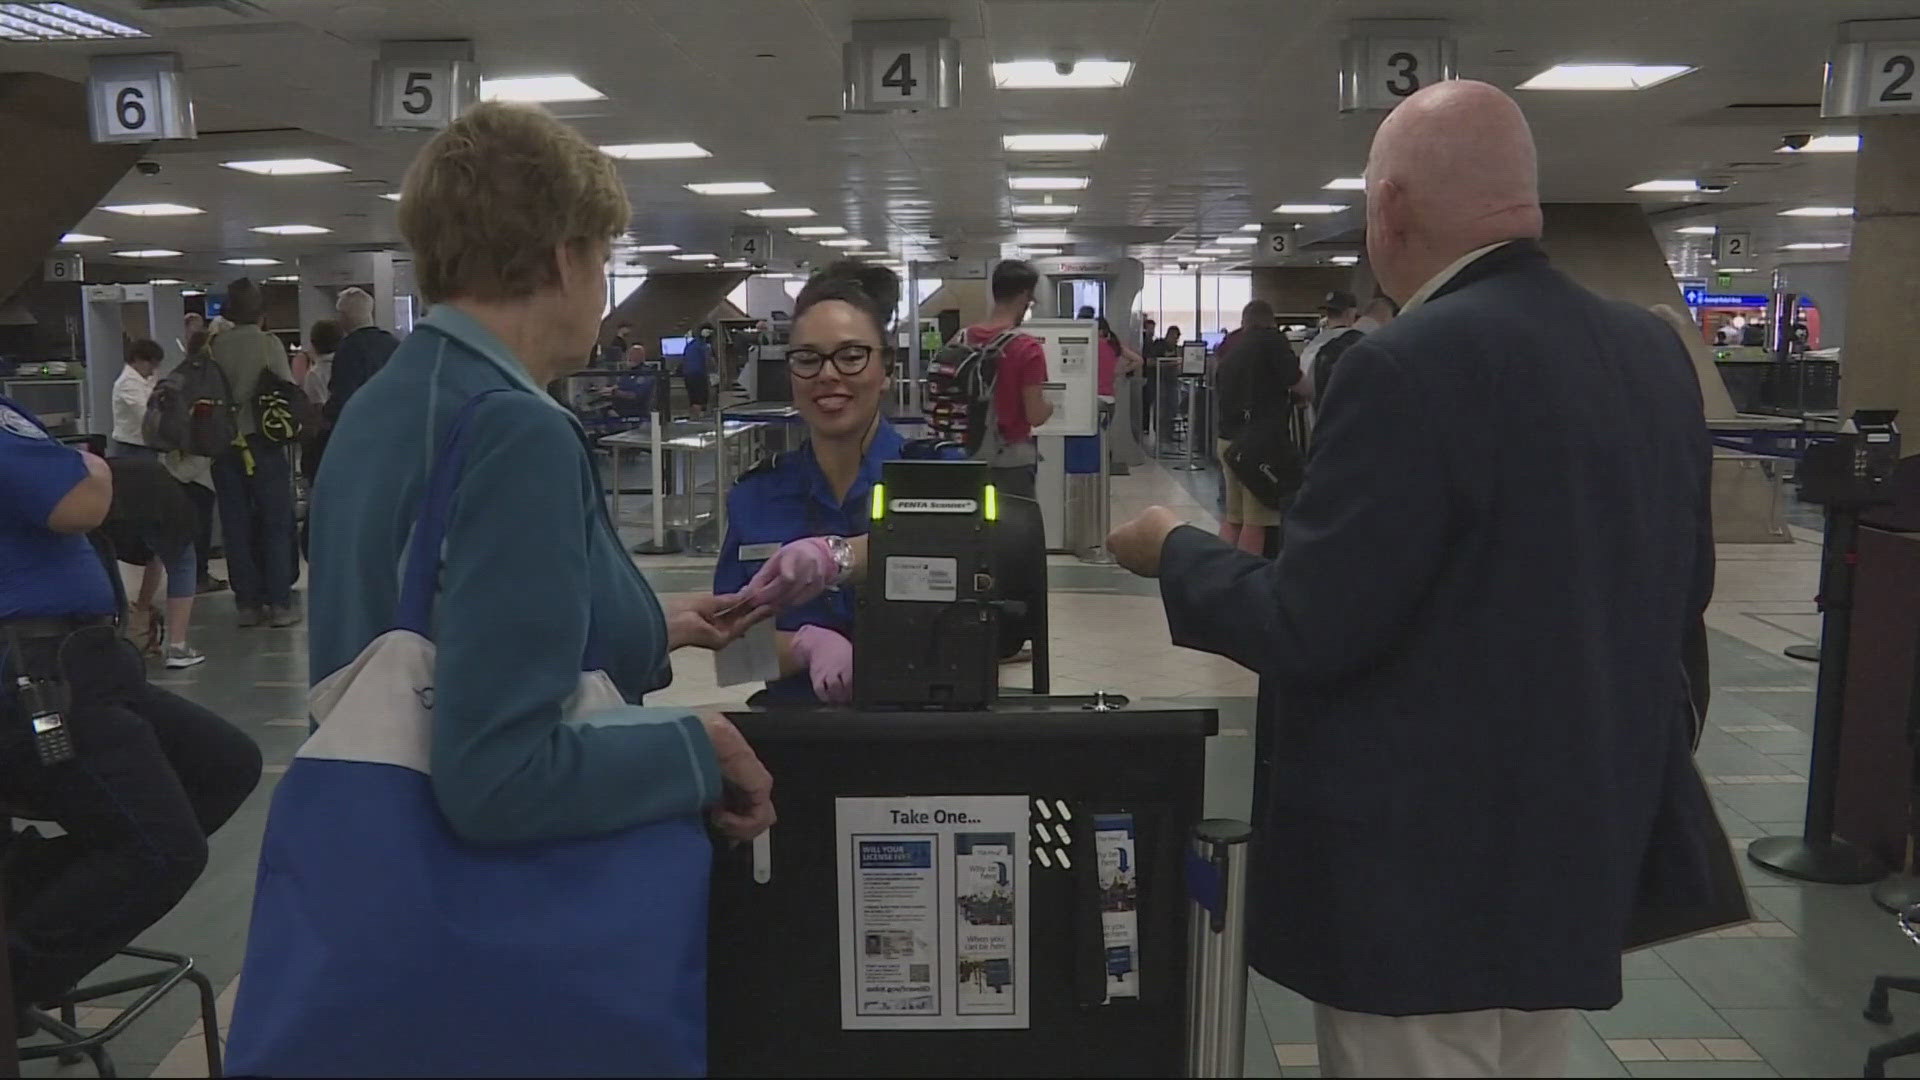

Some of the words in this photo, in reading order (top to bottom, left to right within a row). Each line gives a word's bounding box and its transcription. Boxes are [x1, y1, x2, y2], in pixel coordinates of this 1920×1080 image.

[882, 53, 917, 96] 4
[1386, 52, 1419, 97] 3
[1880, 56, 1915, 101] 2
[402, 72, 433, 115] 5
[116, 87, 146, 130] 6
[743, 239, 756, 254] 4
[1273, 235, 1285, 252] 3
[1730, 239, 1741, 254] 2
[54, 262, 65, 277] 6
[897, 501, 928, 509] PENTA
[890, 809, 929, 825] Take
[933, 809, 982, 825] One...
[862, 845, 882, 853] WILL
[883, 845, 905, 853] YOUR
